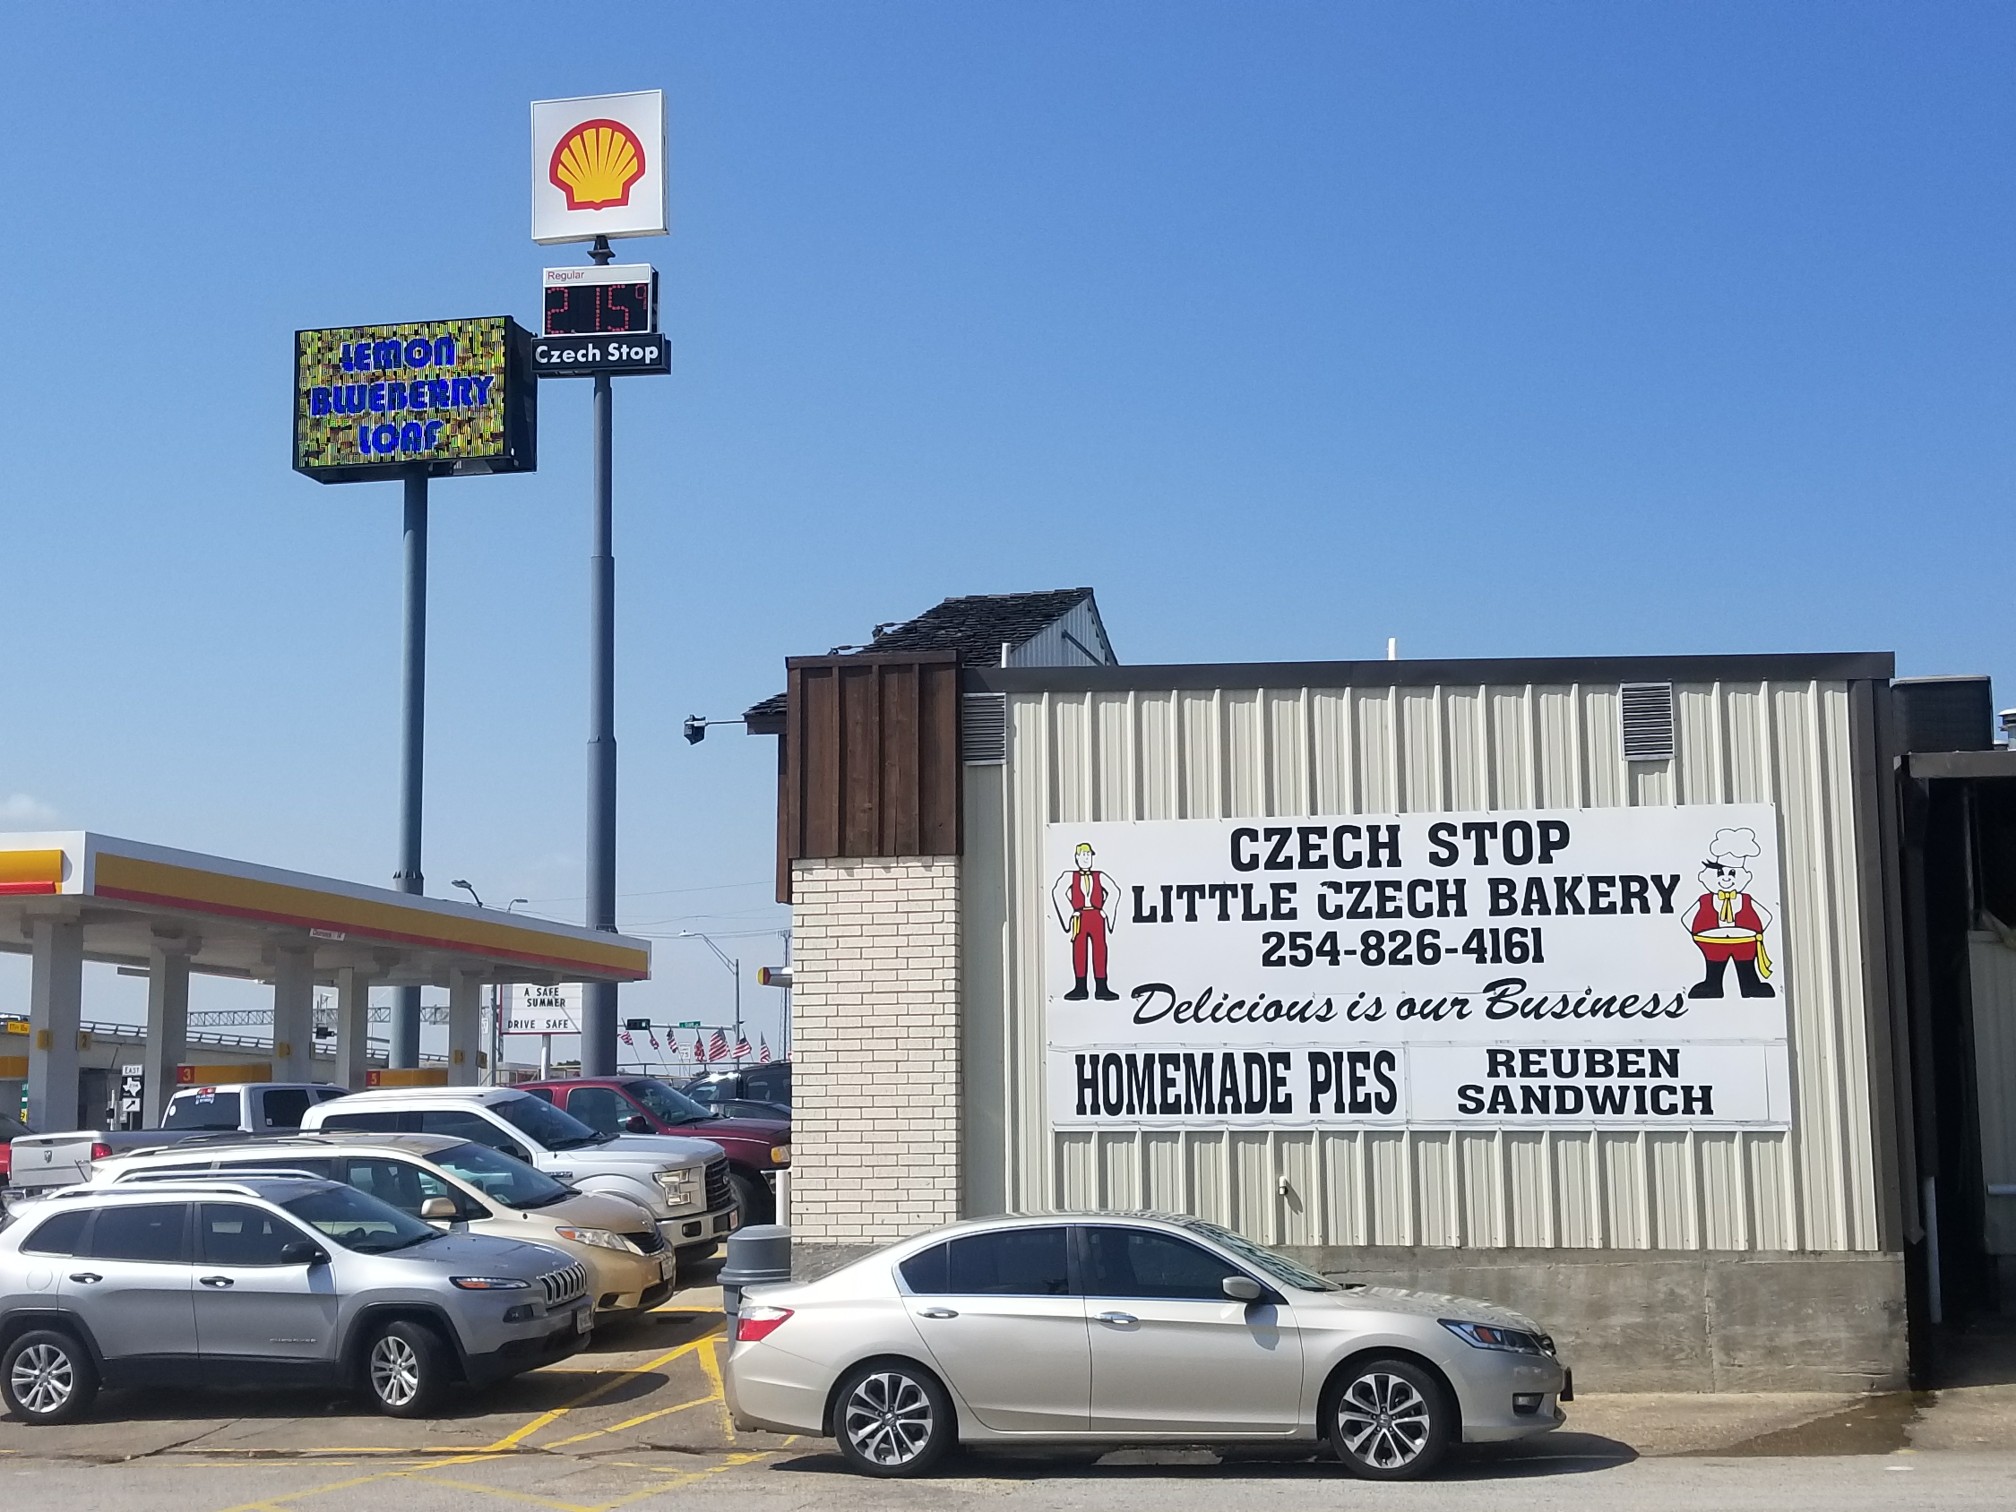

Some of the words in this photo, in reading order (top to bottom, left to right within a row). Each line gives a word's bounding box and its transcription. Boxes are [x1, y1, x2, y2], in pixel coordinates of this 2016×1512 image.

[547, 270, 584, 282] Regular
[340, 336, 456, 373] LEMON
[535, 343, 601, 364] Czech
[607, 342, 659, 365] Stop
[311, 375, 494, 417] BLUEBERRY
[358, 419, 444, 455] LOAF
[1230, 824, 1402, 872] CZECH
[1427, 820, 1571, 868] STOP
[1132, 882, 1298, 924] LITTLE
[1317, 879, 1467, 921] CZECH
[1487, 874, 1681, 917] BAKERY
[1261, 927, 1545, 968] 254-826-4161
[523, 987, 530, 997] A
[536, 987, 560, 997] SAFE
[526, 998, 566, 1008] SUMMER
[1130, 983, 1339, 1025] Delicious
[1346, 991, 1388, 1022] is
[1396, 995, 1473, 1022] our
[1482, 977, 1690, 1021] Business
[507, 1019, 536, 1029] DRIVE
[545, 1019, 569, 1029] SAFE
[125, 1066, 139, 1075] EAST
[182, 1068, 191, 1082] 3
[371, 1073, 377, 1085] 5
[1486, 1048, 1680, 1079] REUBEN
[1075, 1052, 1293, 1117] HOMEMADE
[1307, 1050, 1398, 1116] PIES
[1457, 1085, 1714, 1116] SANDWICH
